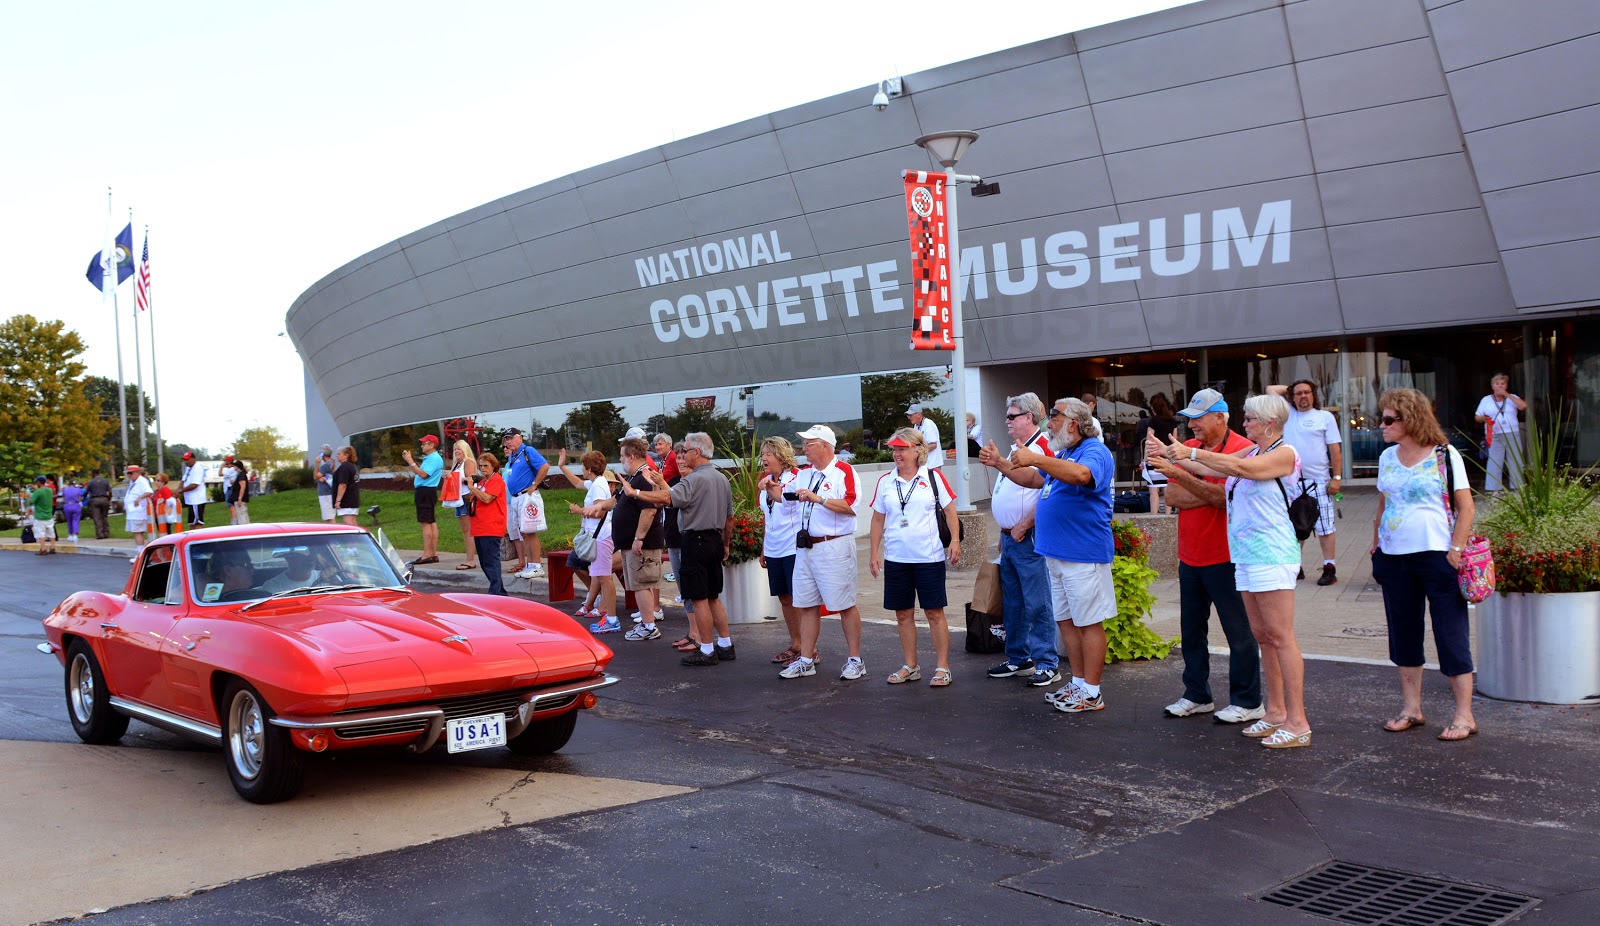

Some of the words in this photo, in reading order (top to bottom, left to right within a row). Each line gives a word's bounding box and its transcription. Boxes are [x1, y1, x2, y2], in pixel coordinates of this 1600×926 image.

[634, 229, 792, 288] NATIONAL
[935, 179, 951, 344] ENTRANCE
[649, 259, 904, 343] CORVETTE
[456, 722, 499, 741] USA-1
